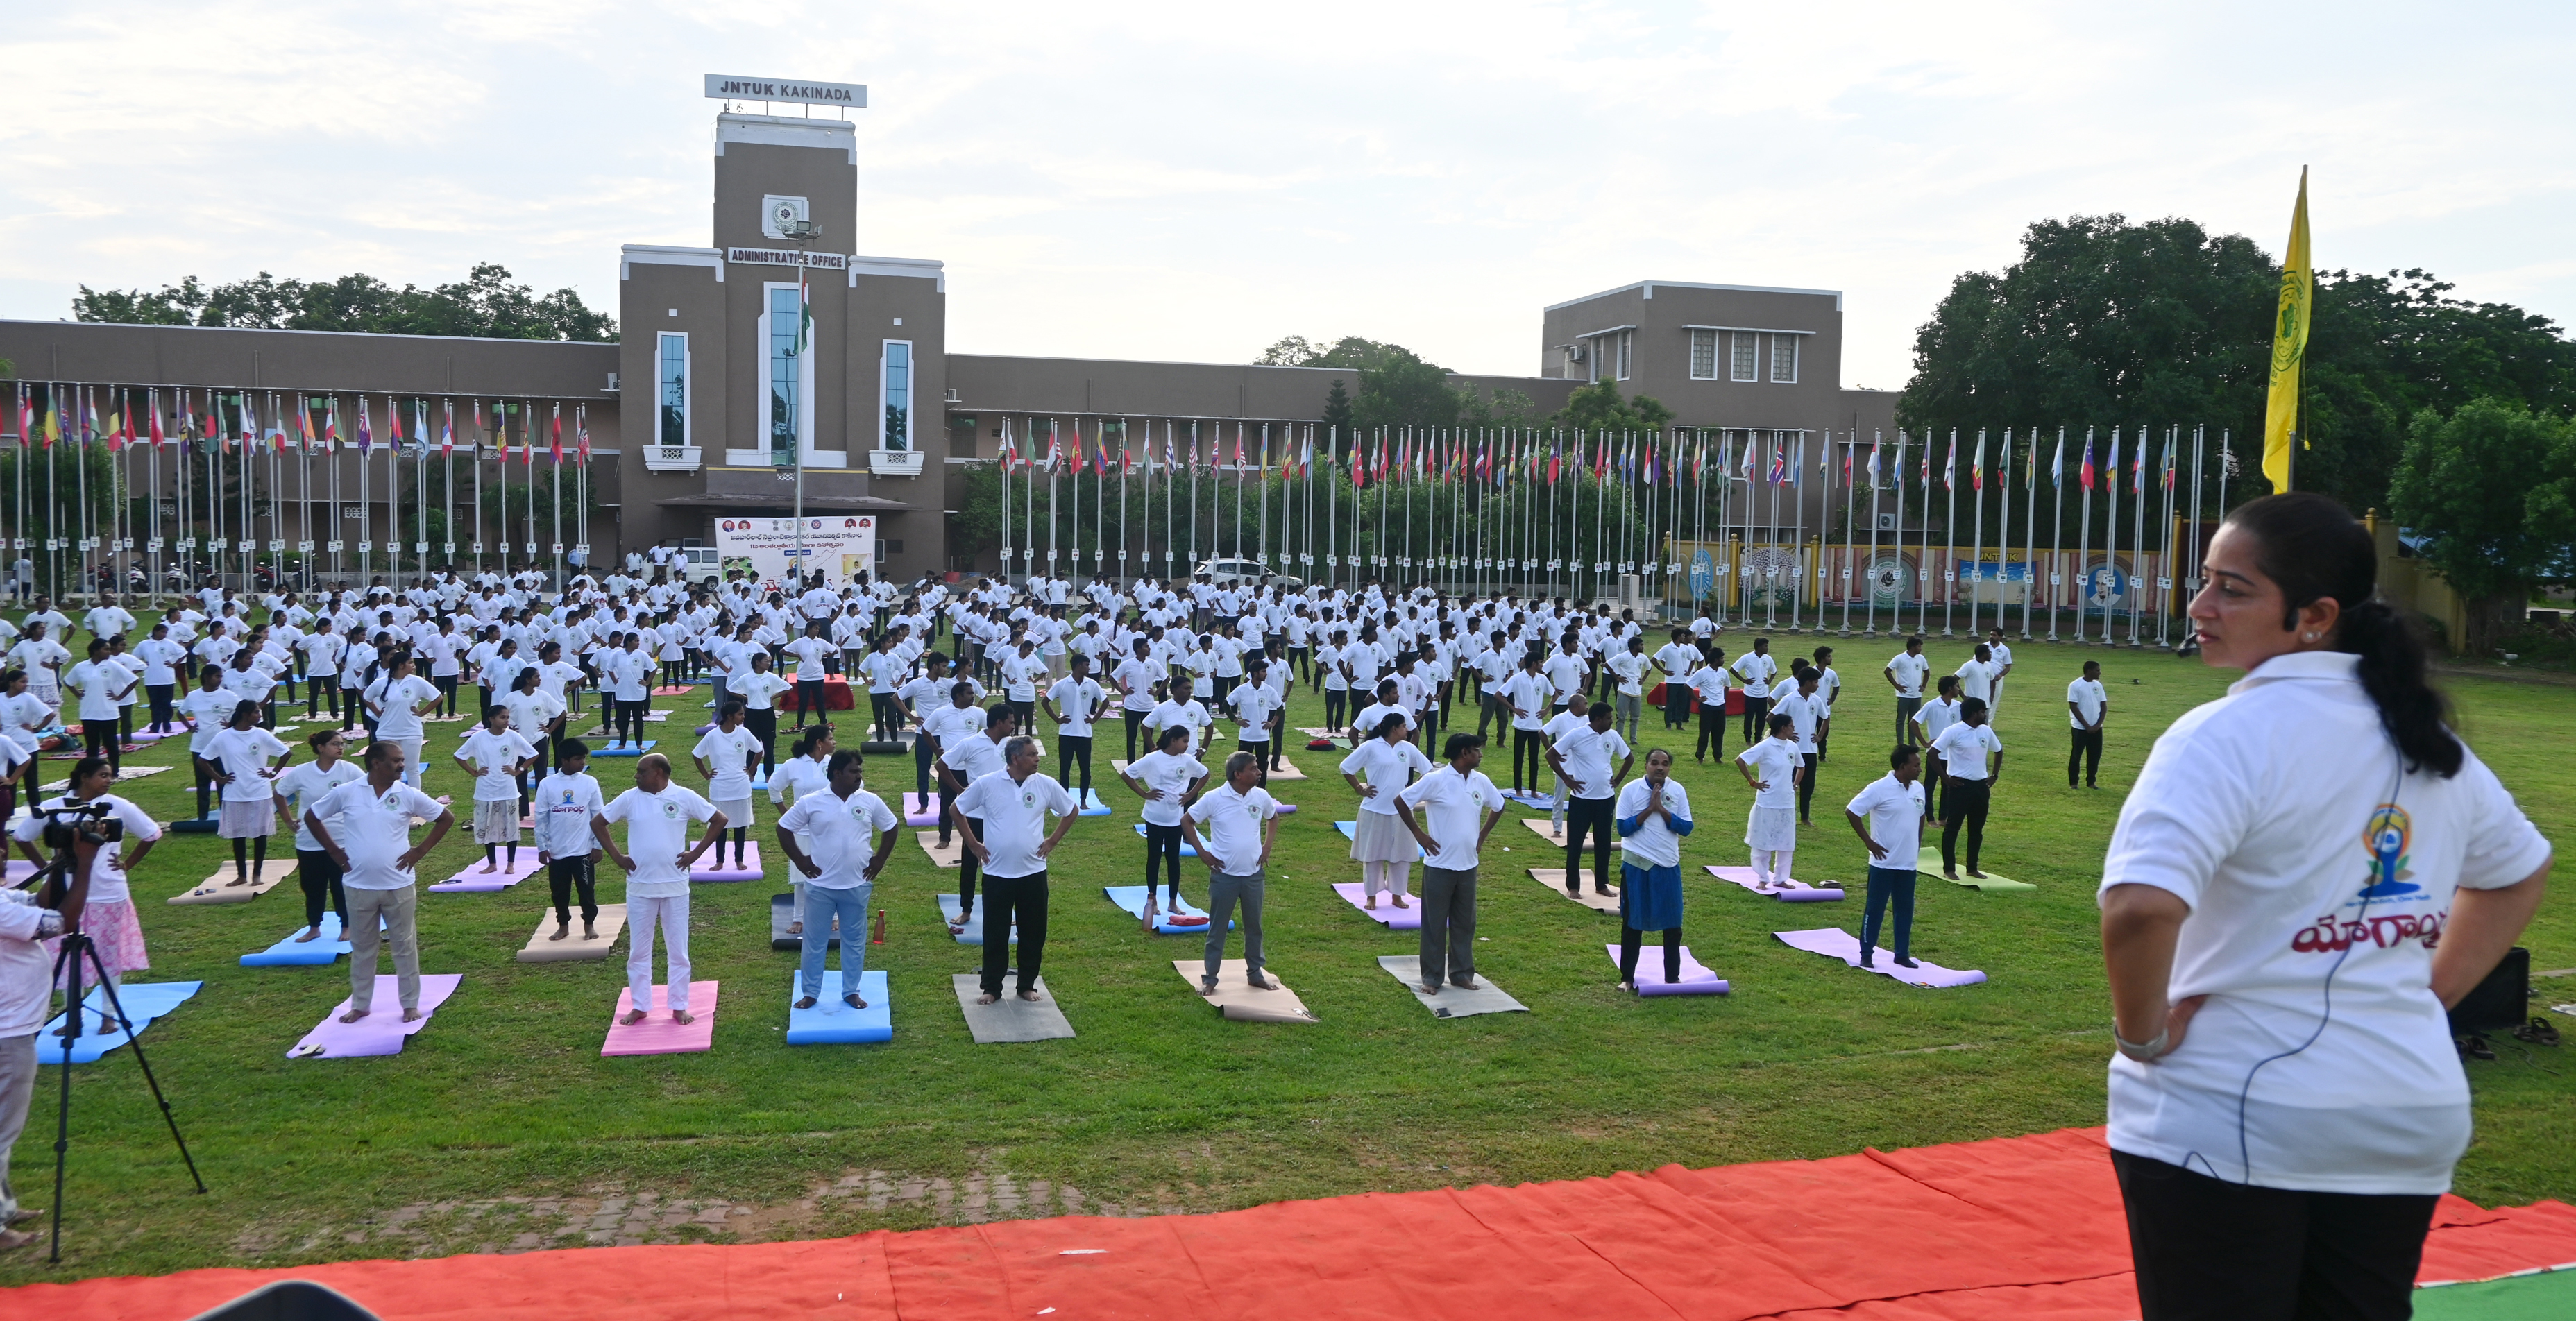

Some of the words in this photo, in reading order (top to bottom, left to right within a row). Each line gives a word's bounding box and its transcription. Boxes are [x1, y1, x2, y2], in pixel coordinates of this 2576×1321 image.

[720, 80, 774, 96] JNTUK
[781, 85, 851, 101] KAKINADA
[732, 250, 808, 265] ADMINISTRATIE
[812, 255, 842, 268] OFFICE
